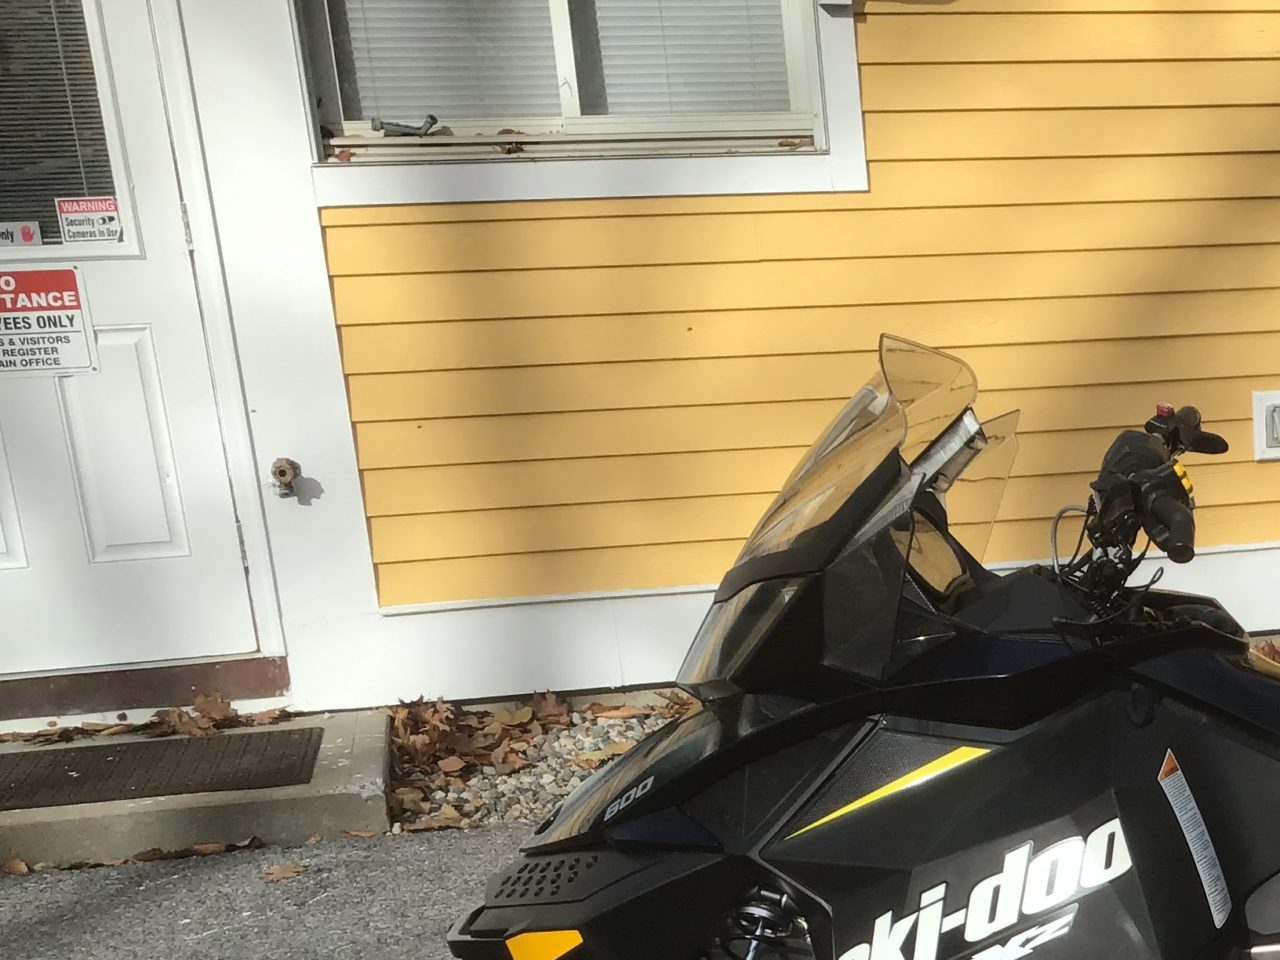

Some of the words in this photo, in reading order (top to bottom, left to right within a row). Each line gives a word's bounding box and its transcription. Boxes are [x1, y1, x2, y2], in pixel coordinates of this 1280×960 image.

[61, 200, 116, 212] WARNING
[65, 215, 95, 228] Security
[0, 228, 14, 242] nly
[67, 228, 97, 239] Cameras
[0, 275, 16, 291] O
[0, 291, 78, 309] TANCE
[36, 314, 75, 329] ONLY
[8, 337, 16, 346] &
[18, 335, 71, 346] VISITORS
[2, 346, 59, 357] REGISTER
[0, 359, 17, 368] AIN
[20, 357, 61, 367] OFFICE
